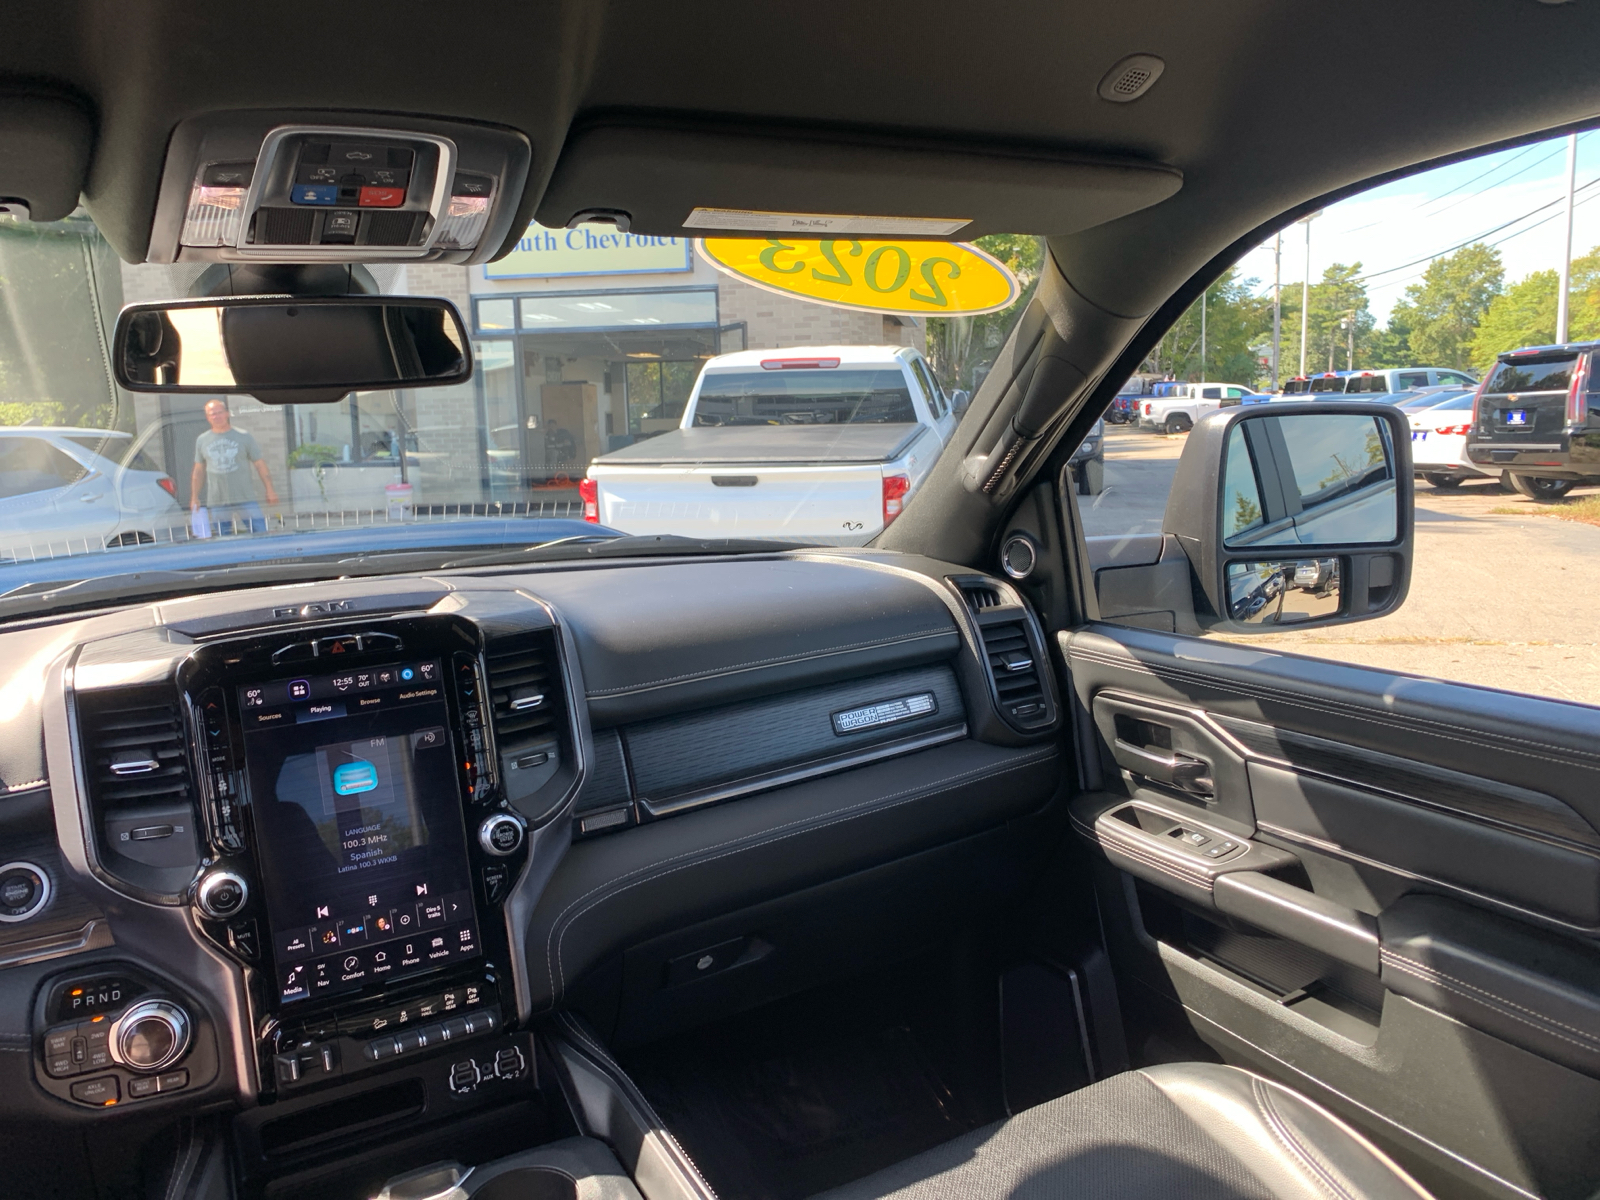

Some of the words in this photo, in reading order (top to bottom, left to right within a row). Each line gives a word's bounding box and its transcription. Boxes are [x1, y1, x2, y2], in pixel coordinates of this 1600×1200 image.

[332, 677, 354, 687] 12:55
[399, 692, 415, 700] Audio
[415, 689, 438, 698] Settings
[360, 698, 381, 706] Browse
[310, 705, 332, 714] Playing
[841, 707, 876, 721] POWER
[258, 713, 282, 722] Sources
[843, 714, 878, 728] WAGON
[370, 738, 385, 748] FM
[345, 823, 381, 837] LANGUAGE
[342, 837, 367, 850] 100.3
[367, 834, 388, 845] MHz
[350, 847, 383, 862] Spanish
[337, 864, 358, 874] Latina
[359, 860, 377, 869] 100.3
[287, 943, 306, 951] Presets
[460, 944, 474, 952] Apps
[429, 950, 450, 959] Vehicle
[402, 958, 421, 967] Phone
[374, 964, 392, 973] Home
[341, 971, 365, 981] Comfort
[283, 986, 303, 996] Media
[73, 998, 81, 1009] P
[86, 995, 95, 1006] R
[99, 992, 108, 1003] N
[112, 990, 121, 1001] D
[54, 1059, 68, 1067] 4WD
[483, 1073, 495, 1081] AUX
